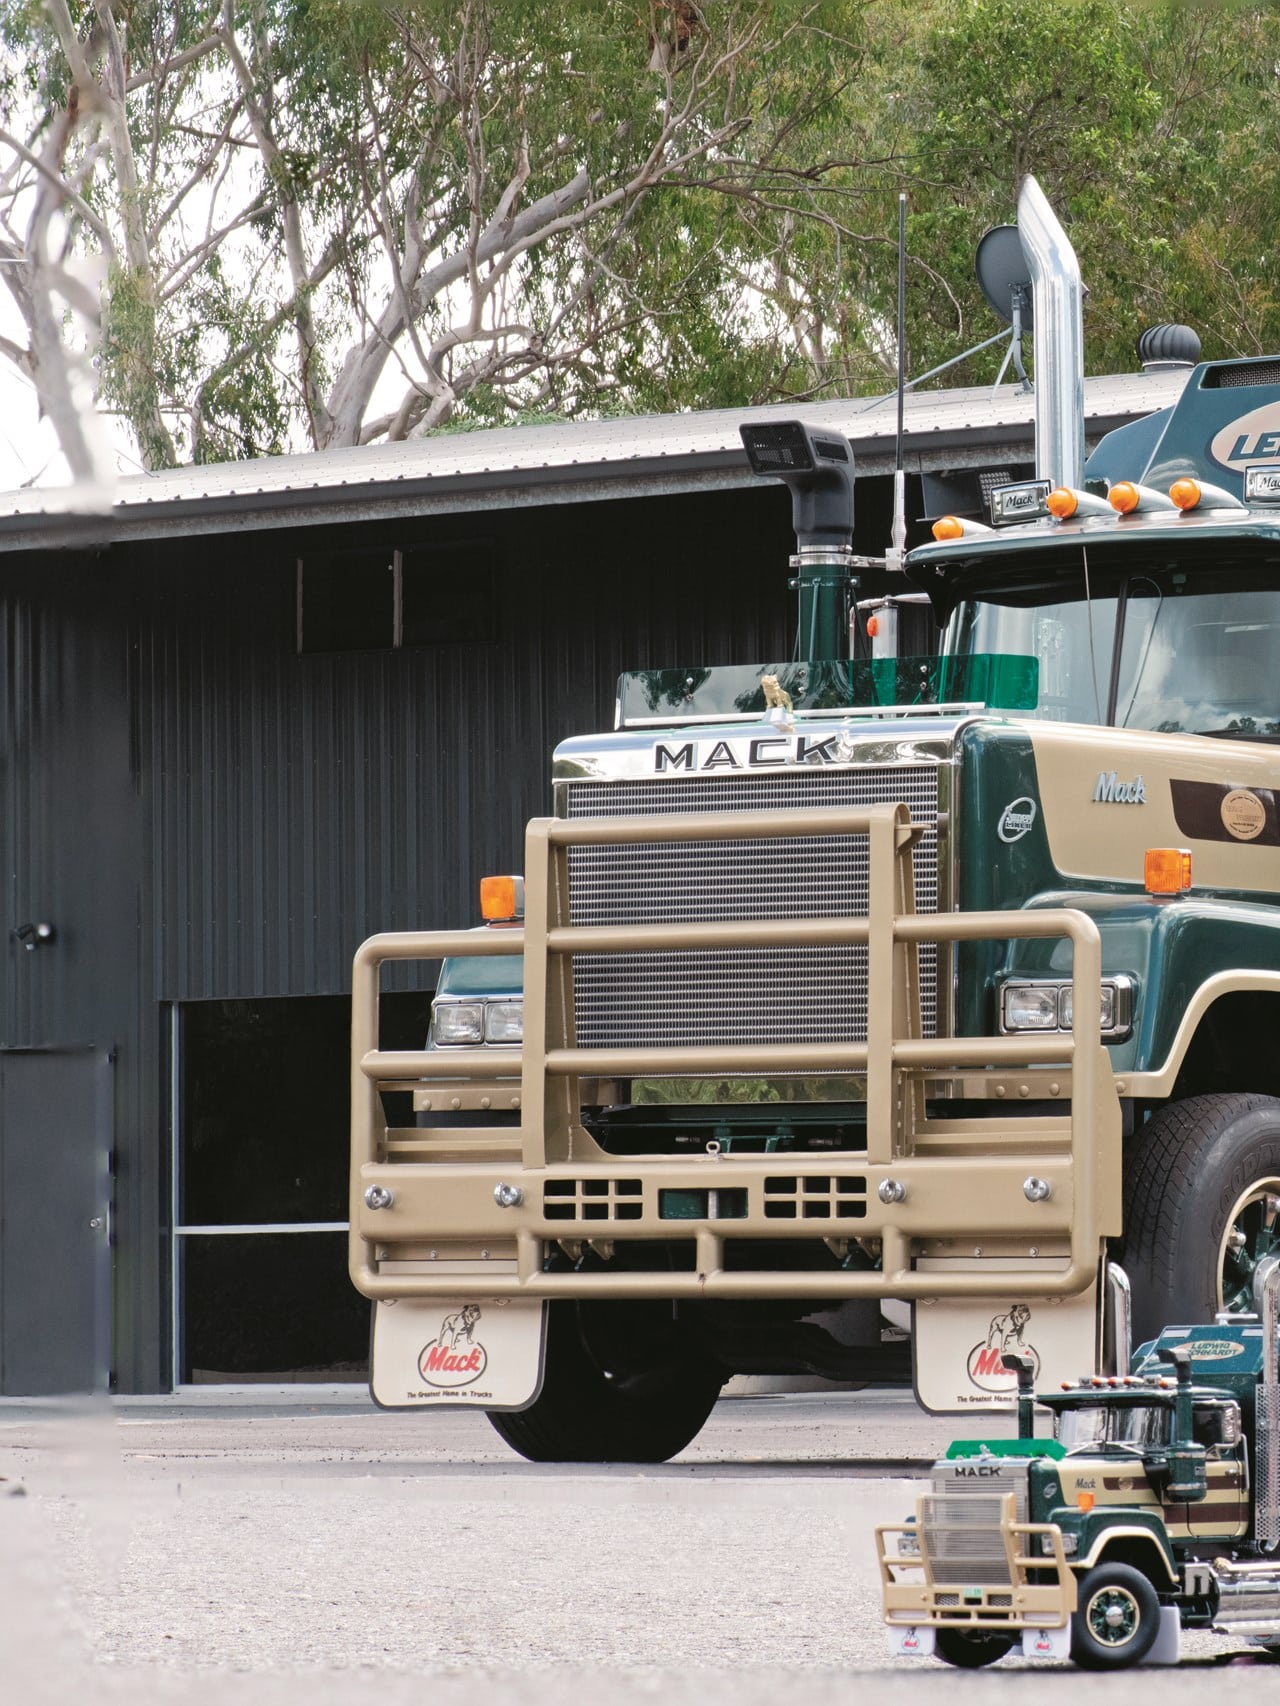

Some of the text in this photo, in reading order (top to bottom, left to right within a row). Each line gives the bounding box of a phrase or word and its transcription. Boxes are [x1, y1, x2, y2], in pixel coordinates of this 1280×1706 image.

[1005, 494, 1033, 508] Mack
[654, 735, 842, 773] MACK
[1092, 771, 1147, 804] Mack
[422, 1346, 481, 1373] Mack
[955, 1466, 1001, 1478] MACK
[1075, 1477, 1097, 1489] Mack
